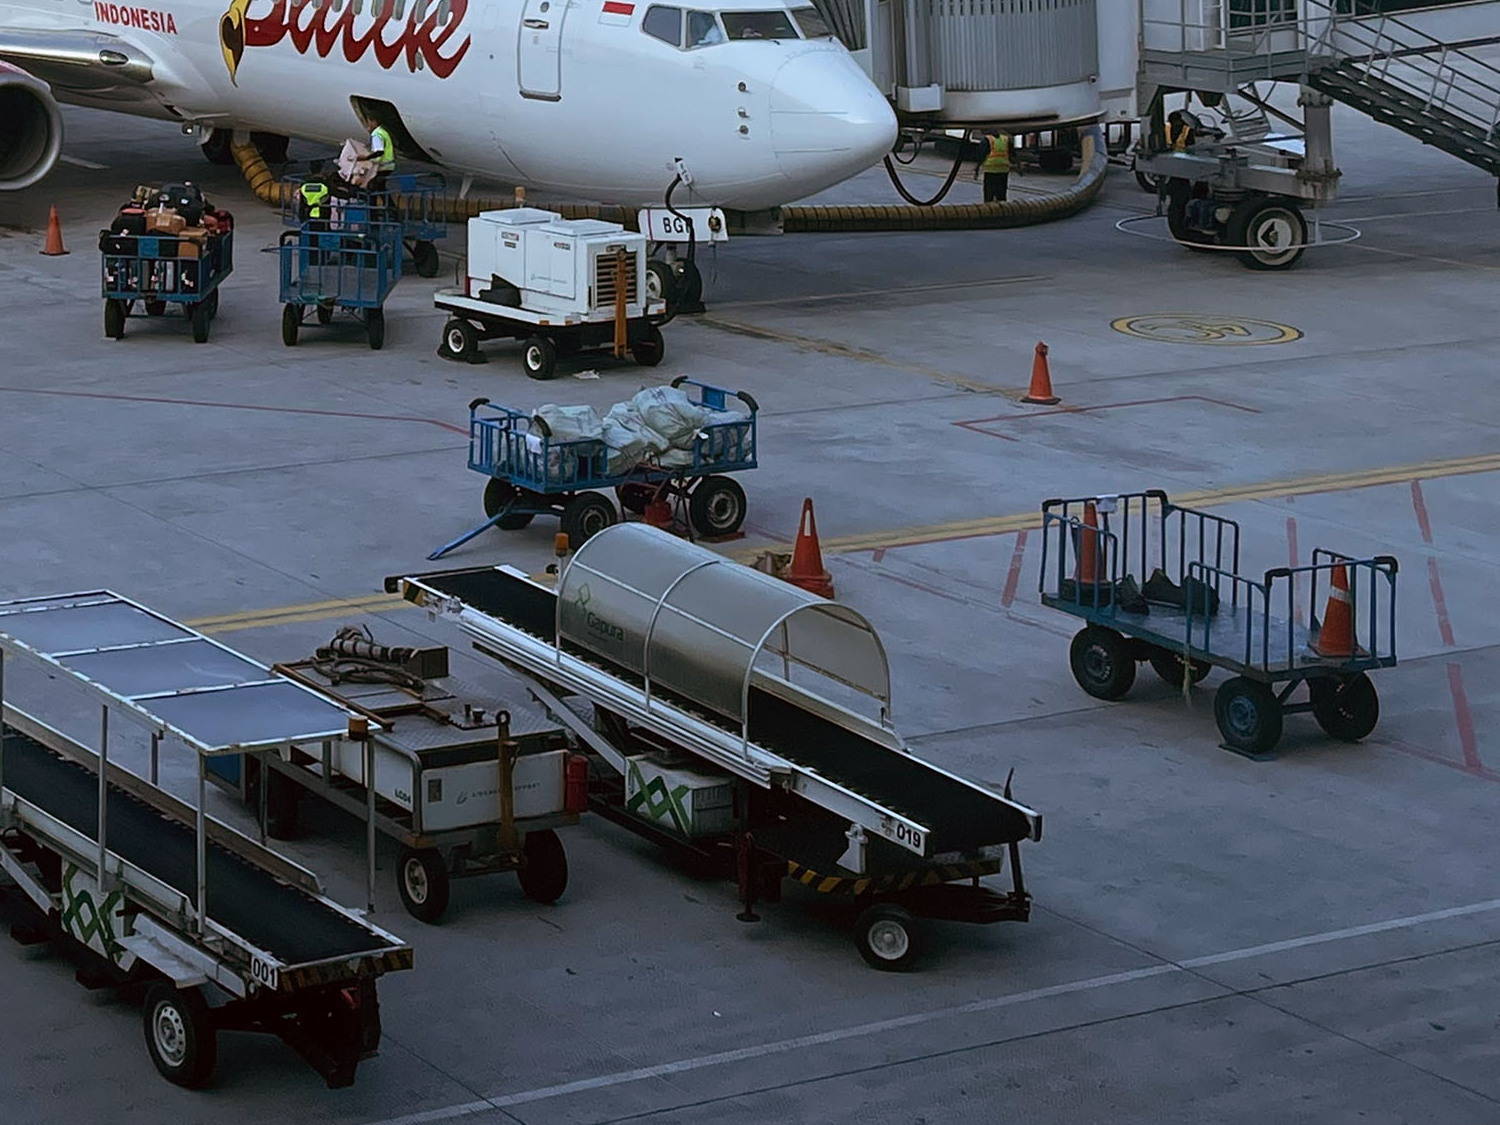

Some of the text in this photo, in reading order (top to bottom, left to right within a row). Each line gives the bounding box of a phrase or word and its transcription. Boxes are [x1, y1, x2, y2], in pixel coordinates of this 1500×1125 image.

[94, 1, 178, 35] INDONESIA
[662, 216, 690, 234] BG
[587, 612, 624, 641] Gapura
[897, 823, 921, 848] 019
[253, 958, 275, 987] 001
